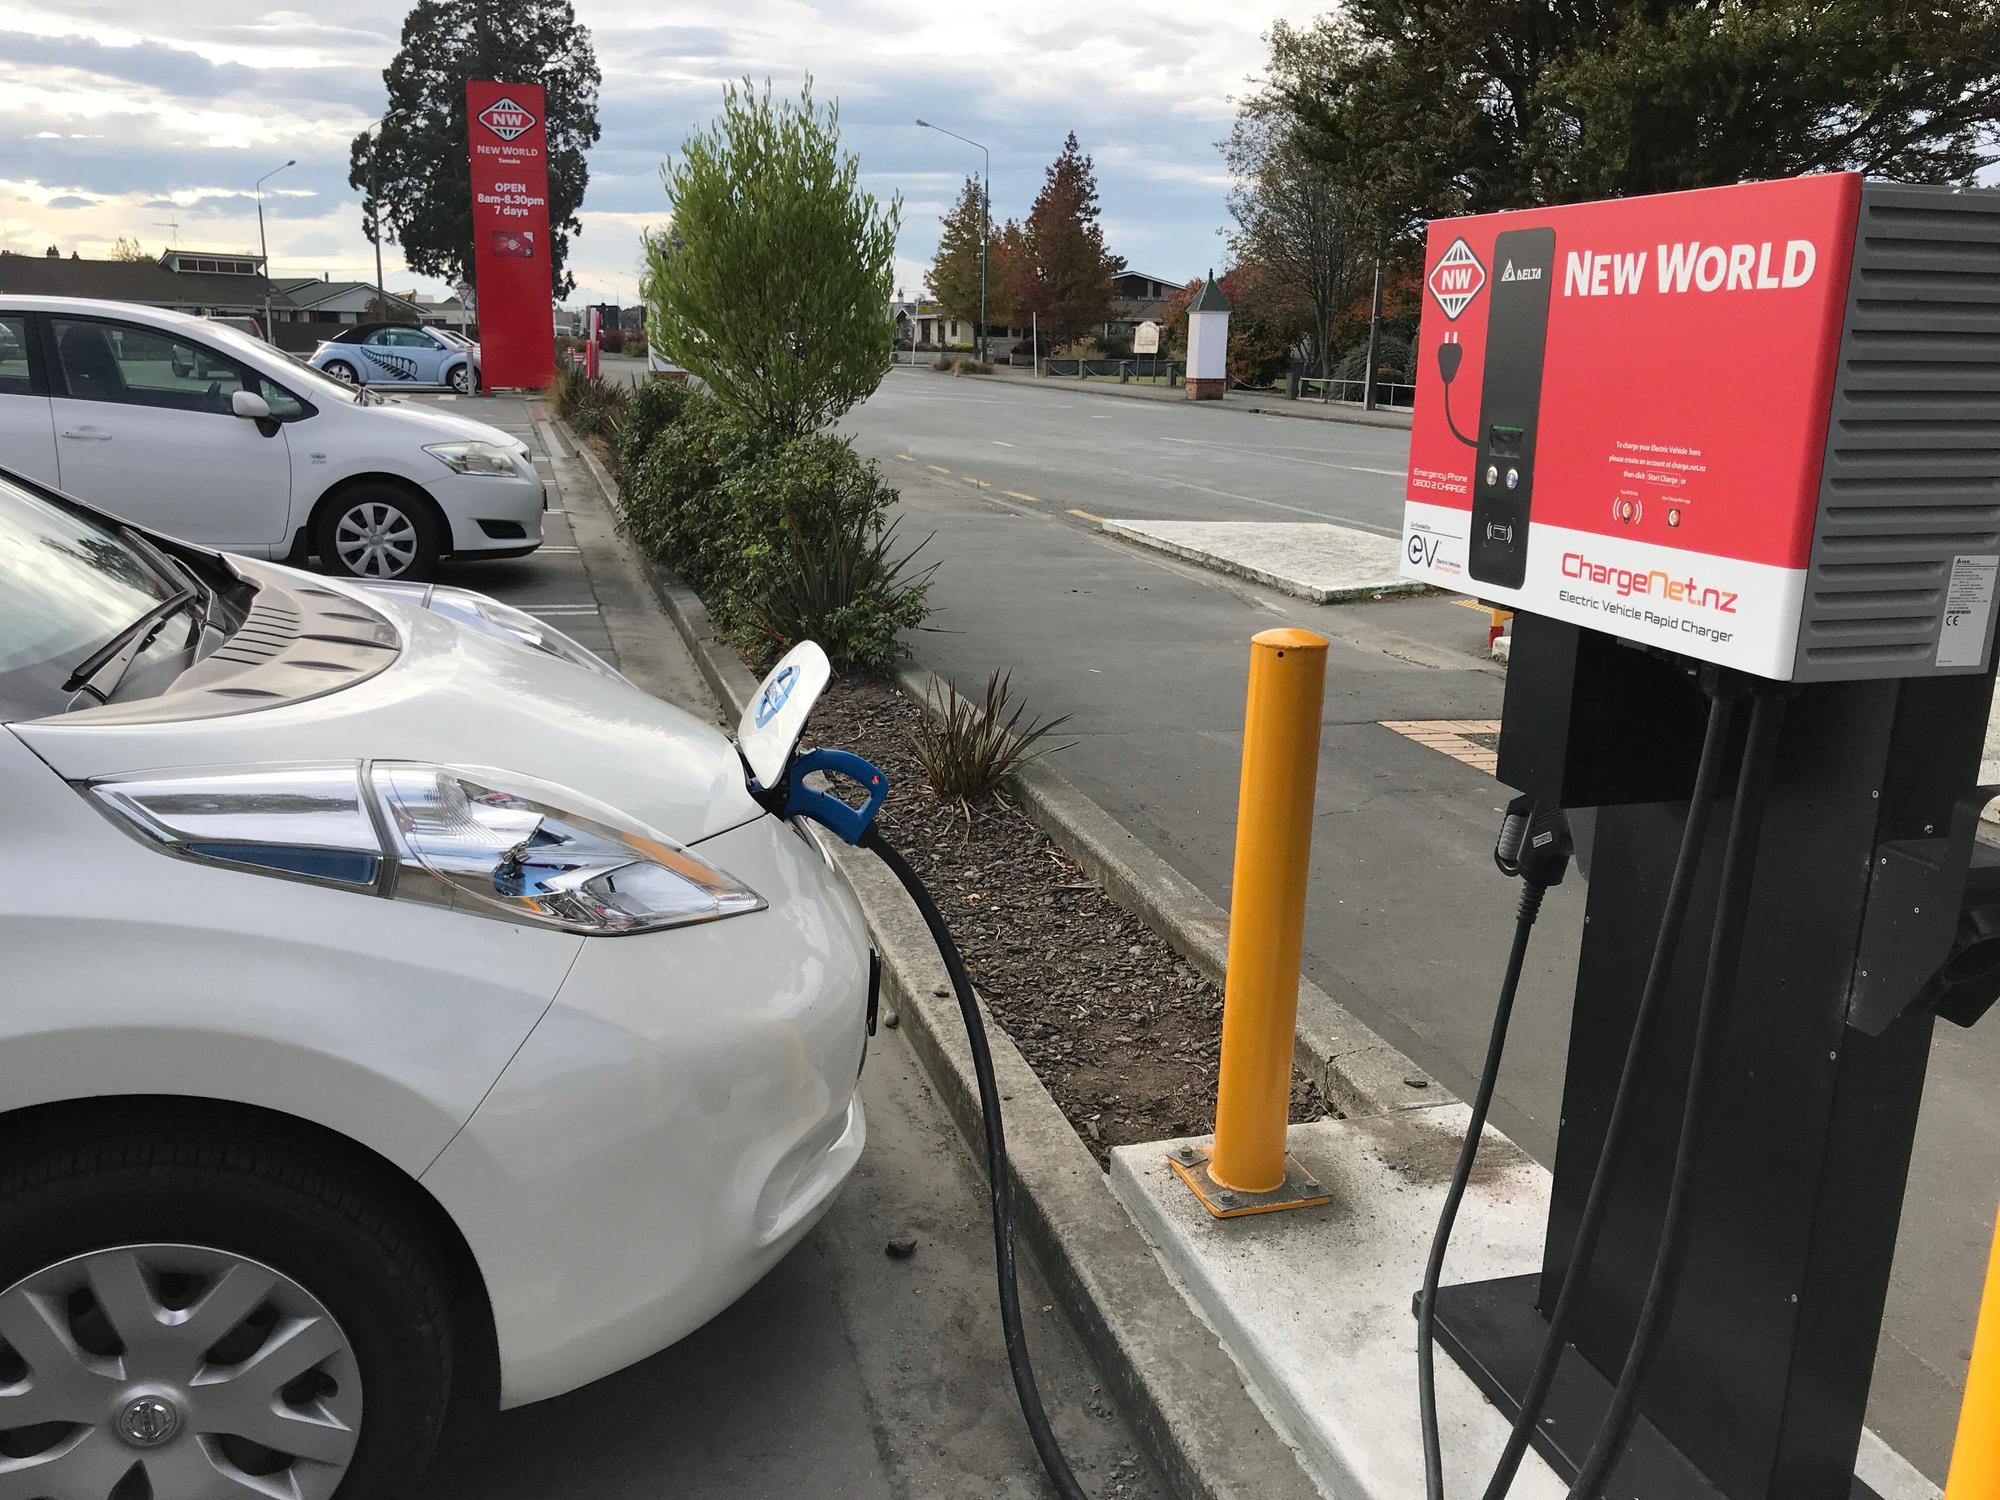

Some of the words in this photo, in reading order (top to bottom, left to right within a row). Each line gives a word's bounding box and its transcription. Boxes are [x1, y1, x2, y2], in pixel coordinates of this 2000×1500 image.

[492, 113, 522, 126] NW
[477, 145, 501, 154] NEW
[502, 146, 538, 156] WORLD
[495, 183, 526, 193] OPEN
[477, 193, 544, 206] 8am-8.30pm
[494, 205, 501, 215] 7
[503, 207, 528, 217] days
[1517, 268, 1541, 280] DELTA
[1564, 250, 1648, 297] NEW
[1657, 240, 1816, 293] WORLD
[1441, 268, 1472, 290] NW
[1623, 442, 1639, 451] charge
[1651, 445, 1668, 453] Electric
[1669, 446, 1688, 455] Vehicle
[1689, 448, 1701, 456] here
[1609, 455, 1624, 463] please
[1646, 459, 1665, 467] account
[1672, 463, 1706, 472] charge.net.nz
[1413, 468, 1447, 481] Emergency
[1447, 472, 1468, 483] Phone
[1624, 470, 1634, 478] then
[1648, 473, 1659, 481] Start
[1660, 475, 1678, 485] Charge
[1412, 479, 1431, 489] 0800
[1437, 482, 1467, 494] CHARGE
[1561, 553, 1738, 613] ChargeNet.nz
[1559, 591, 1599, 610] Electric
[1602, 600, 1641, 620] Vehicle
[1644, 611, 1679, 630] Rapid
[1681, 621, 1733, 643] Charger
